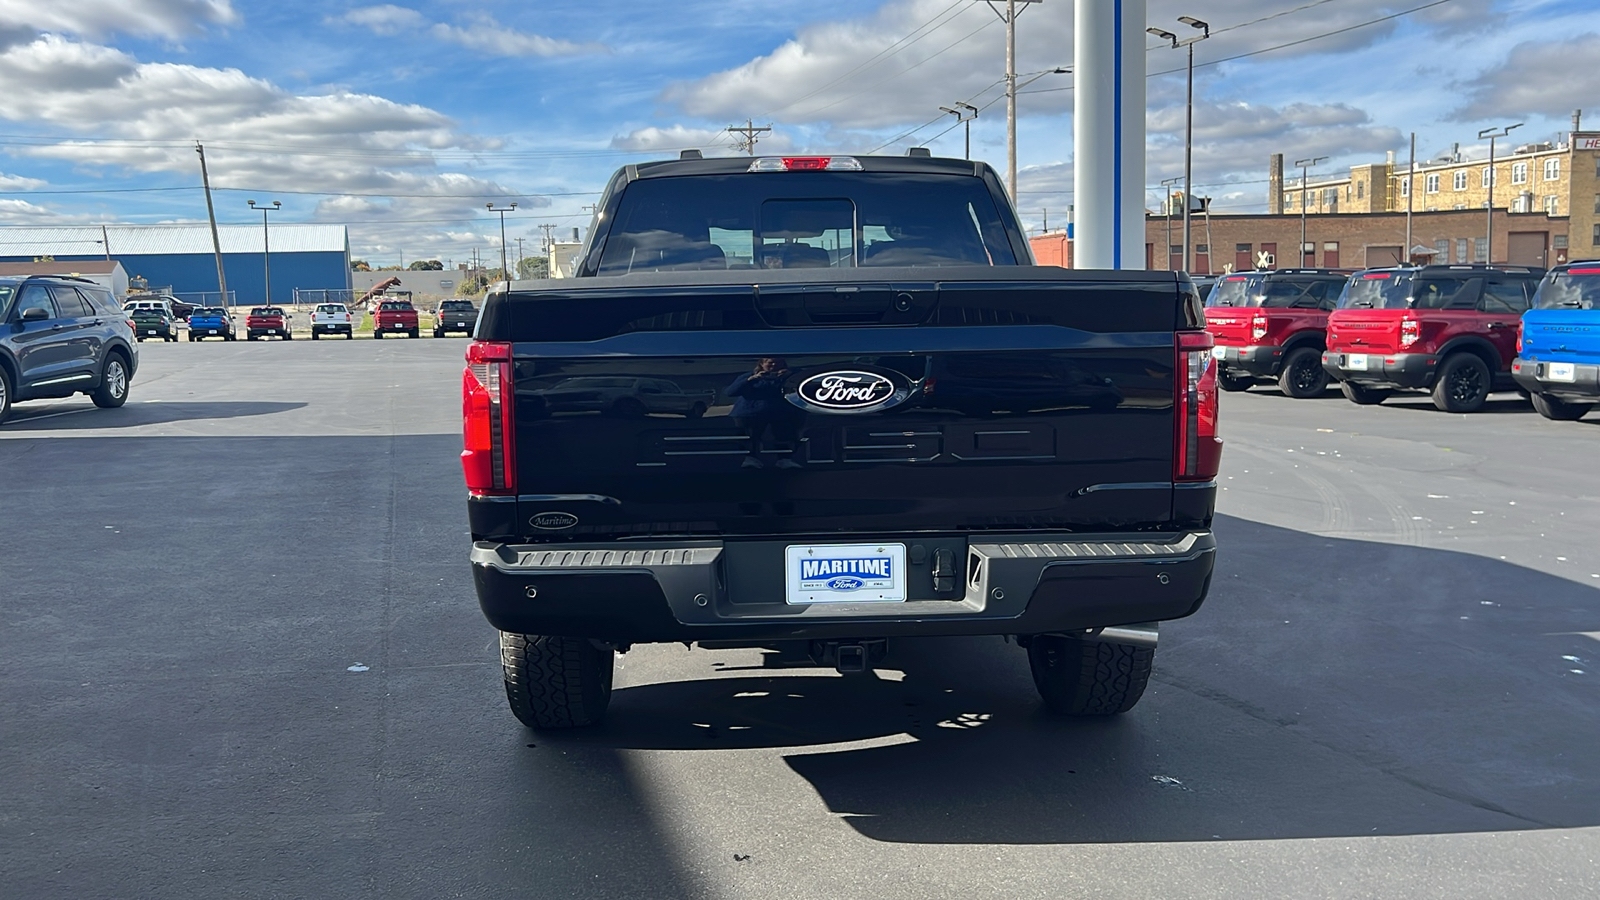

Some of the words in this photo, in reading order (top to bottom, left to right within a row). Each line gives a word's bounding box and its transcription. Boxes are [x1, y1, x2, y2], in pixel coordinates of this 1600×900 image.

[815, 375, 877, 401] Ford
[534, 516, 573, 526] Maritime
[803, 559, 889, 579] MARITIME
[833, 579, 857, 588] Ford
